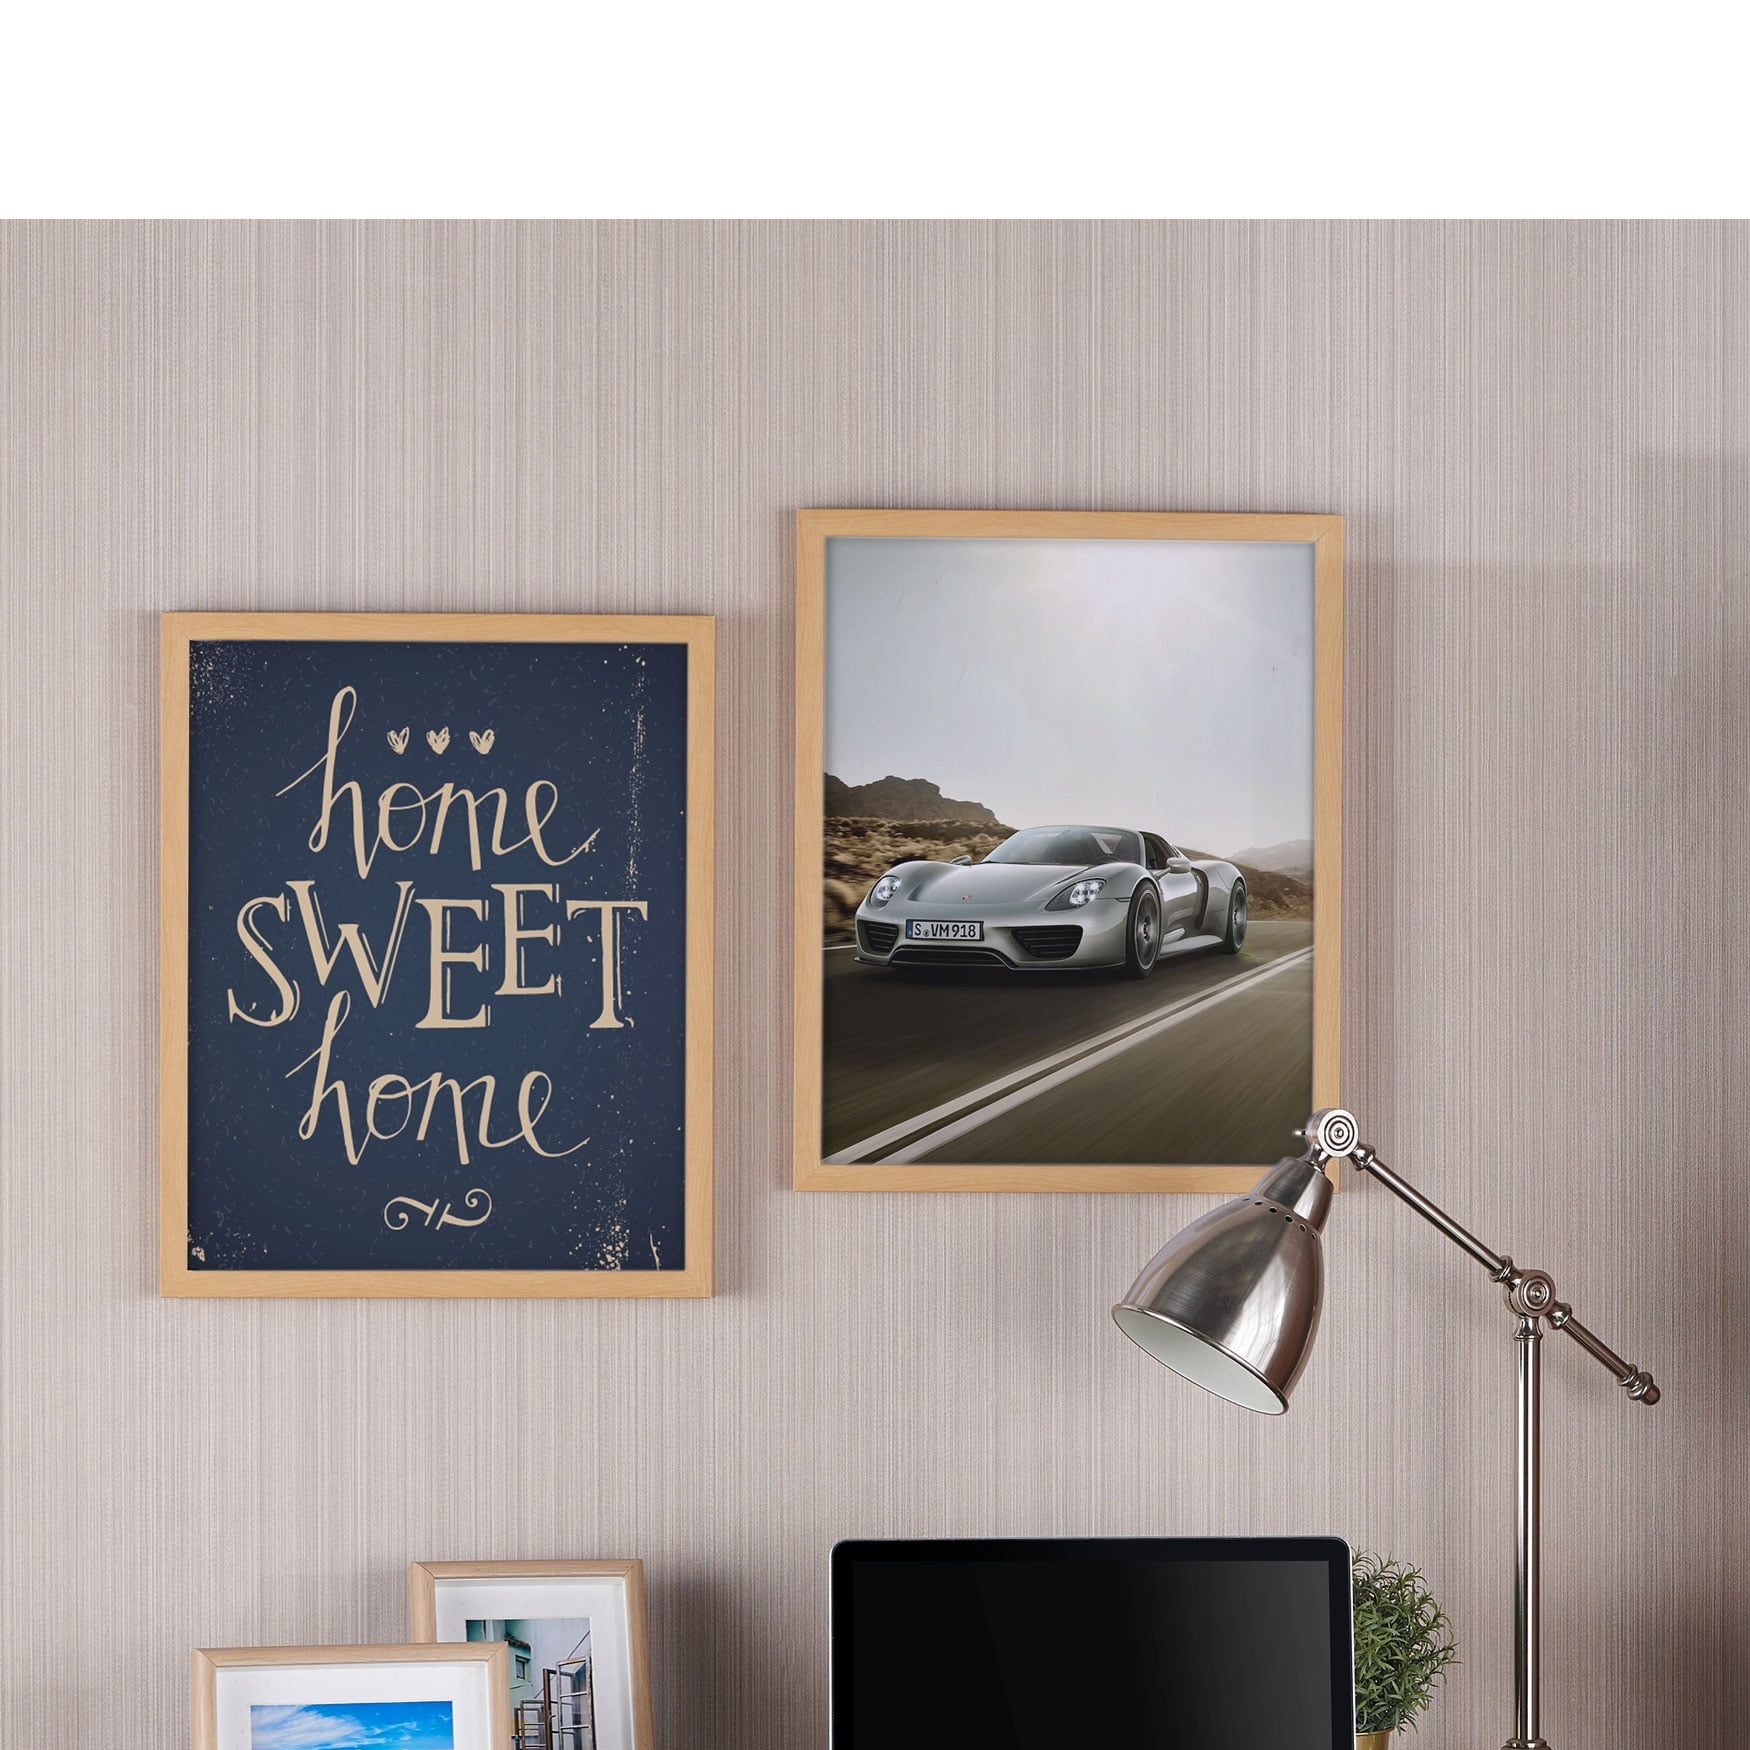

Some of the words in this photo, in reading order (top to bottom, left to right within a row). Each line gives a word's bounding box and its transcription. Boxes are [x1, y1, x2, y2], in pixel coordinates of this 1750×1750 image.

[277, 686, 601, 878] home
[227, 880, 648, 1029] SWEET
[931, 923, 950, 937] VM
[951, 924, 977, 938] 918
[285, 990, 591, 1165] home
